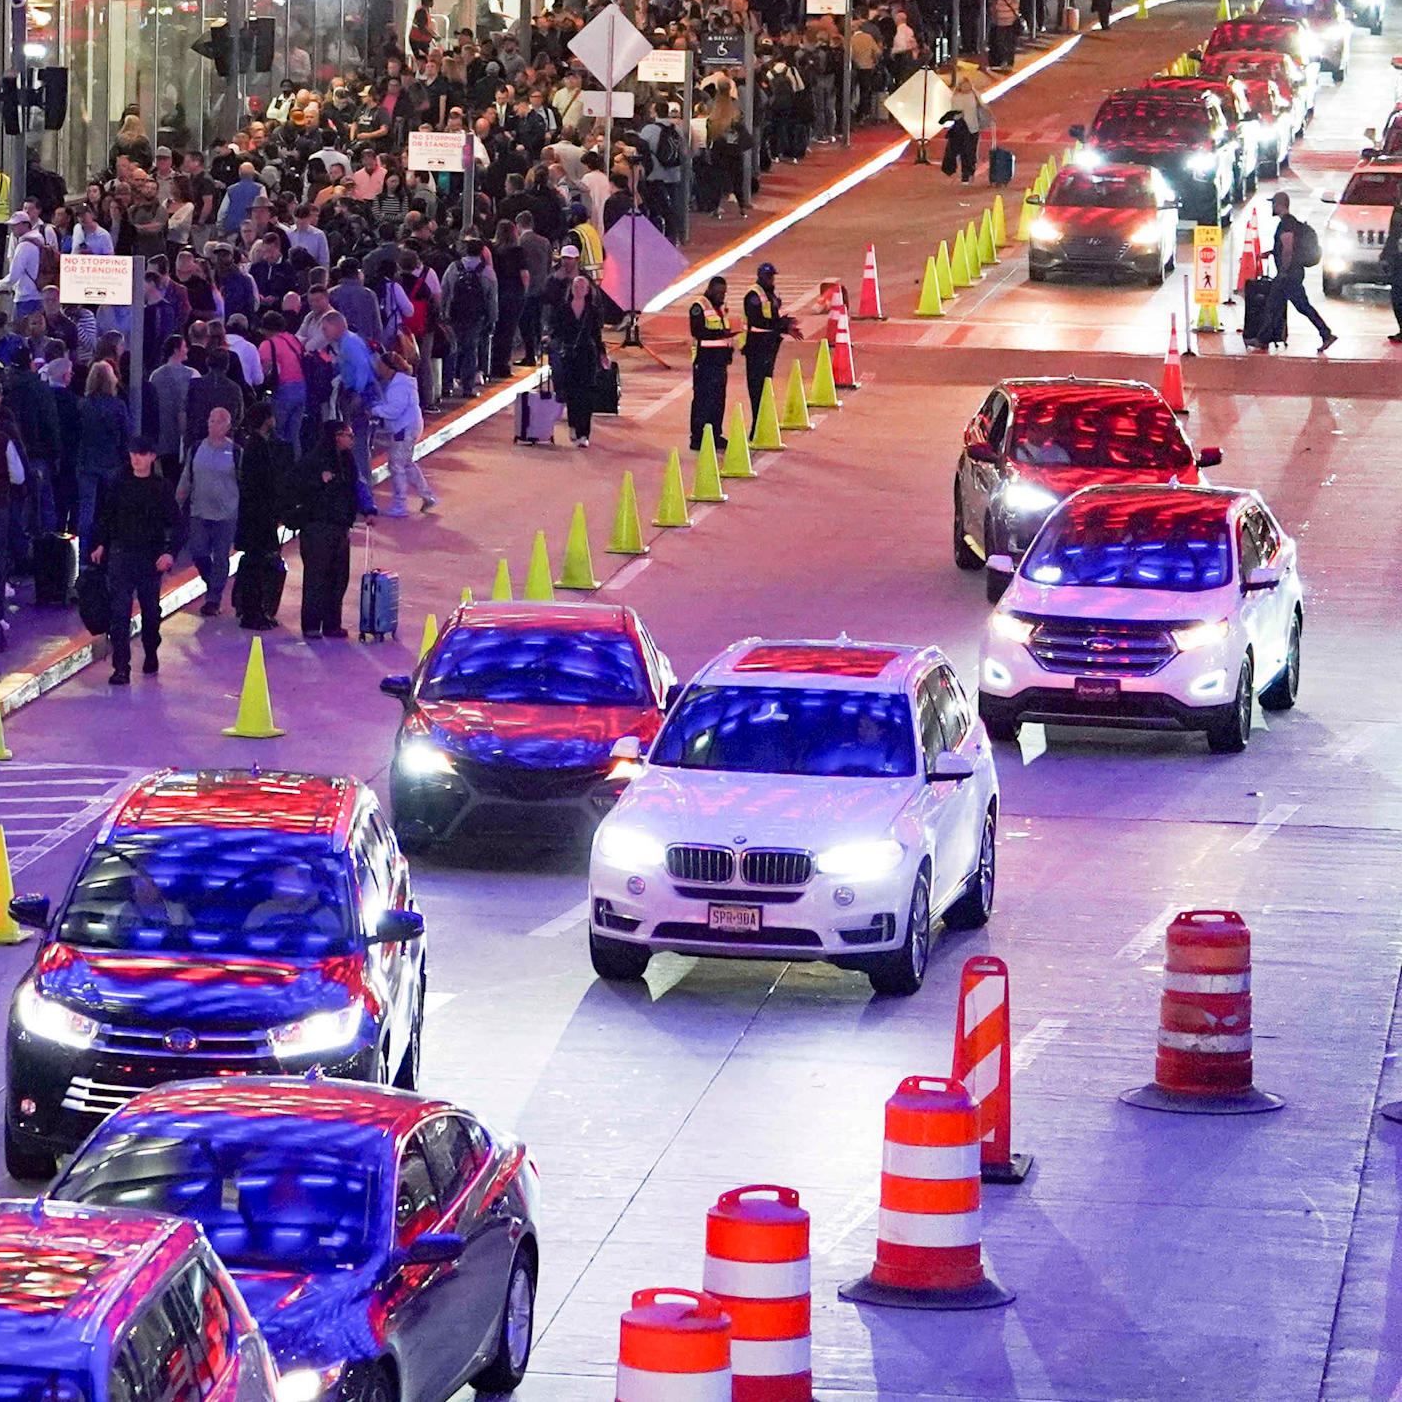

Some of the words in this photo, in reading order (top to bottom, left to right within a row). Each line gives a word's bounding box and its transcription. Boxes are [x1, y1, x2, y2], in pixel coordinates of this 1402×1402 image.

[64, 257, 78, 265] NO
[81, 258, 128, 266] STOPPING
[80, 266, 129, 275] STANDING
